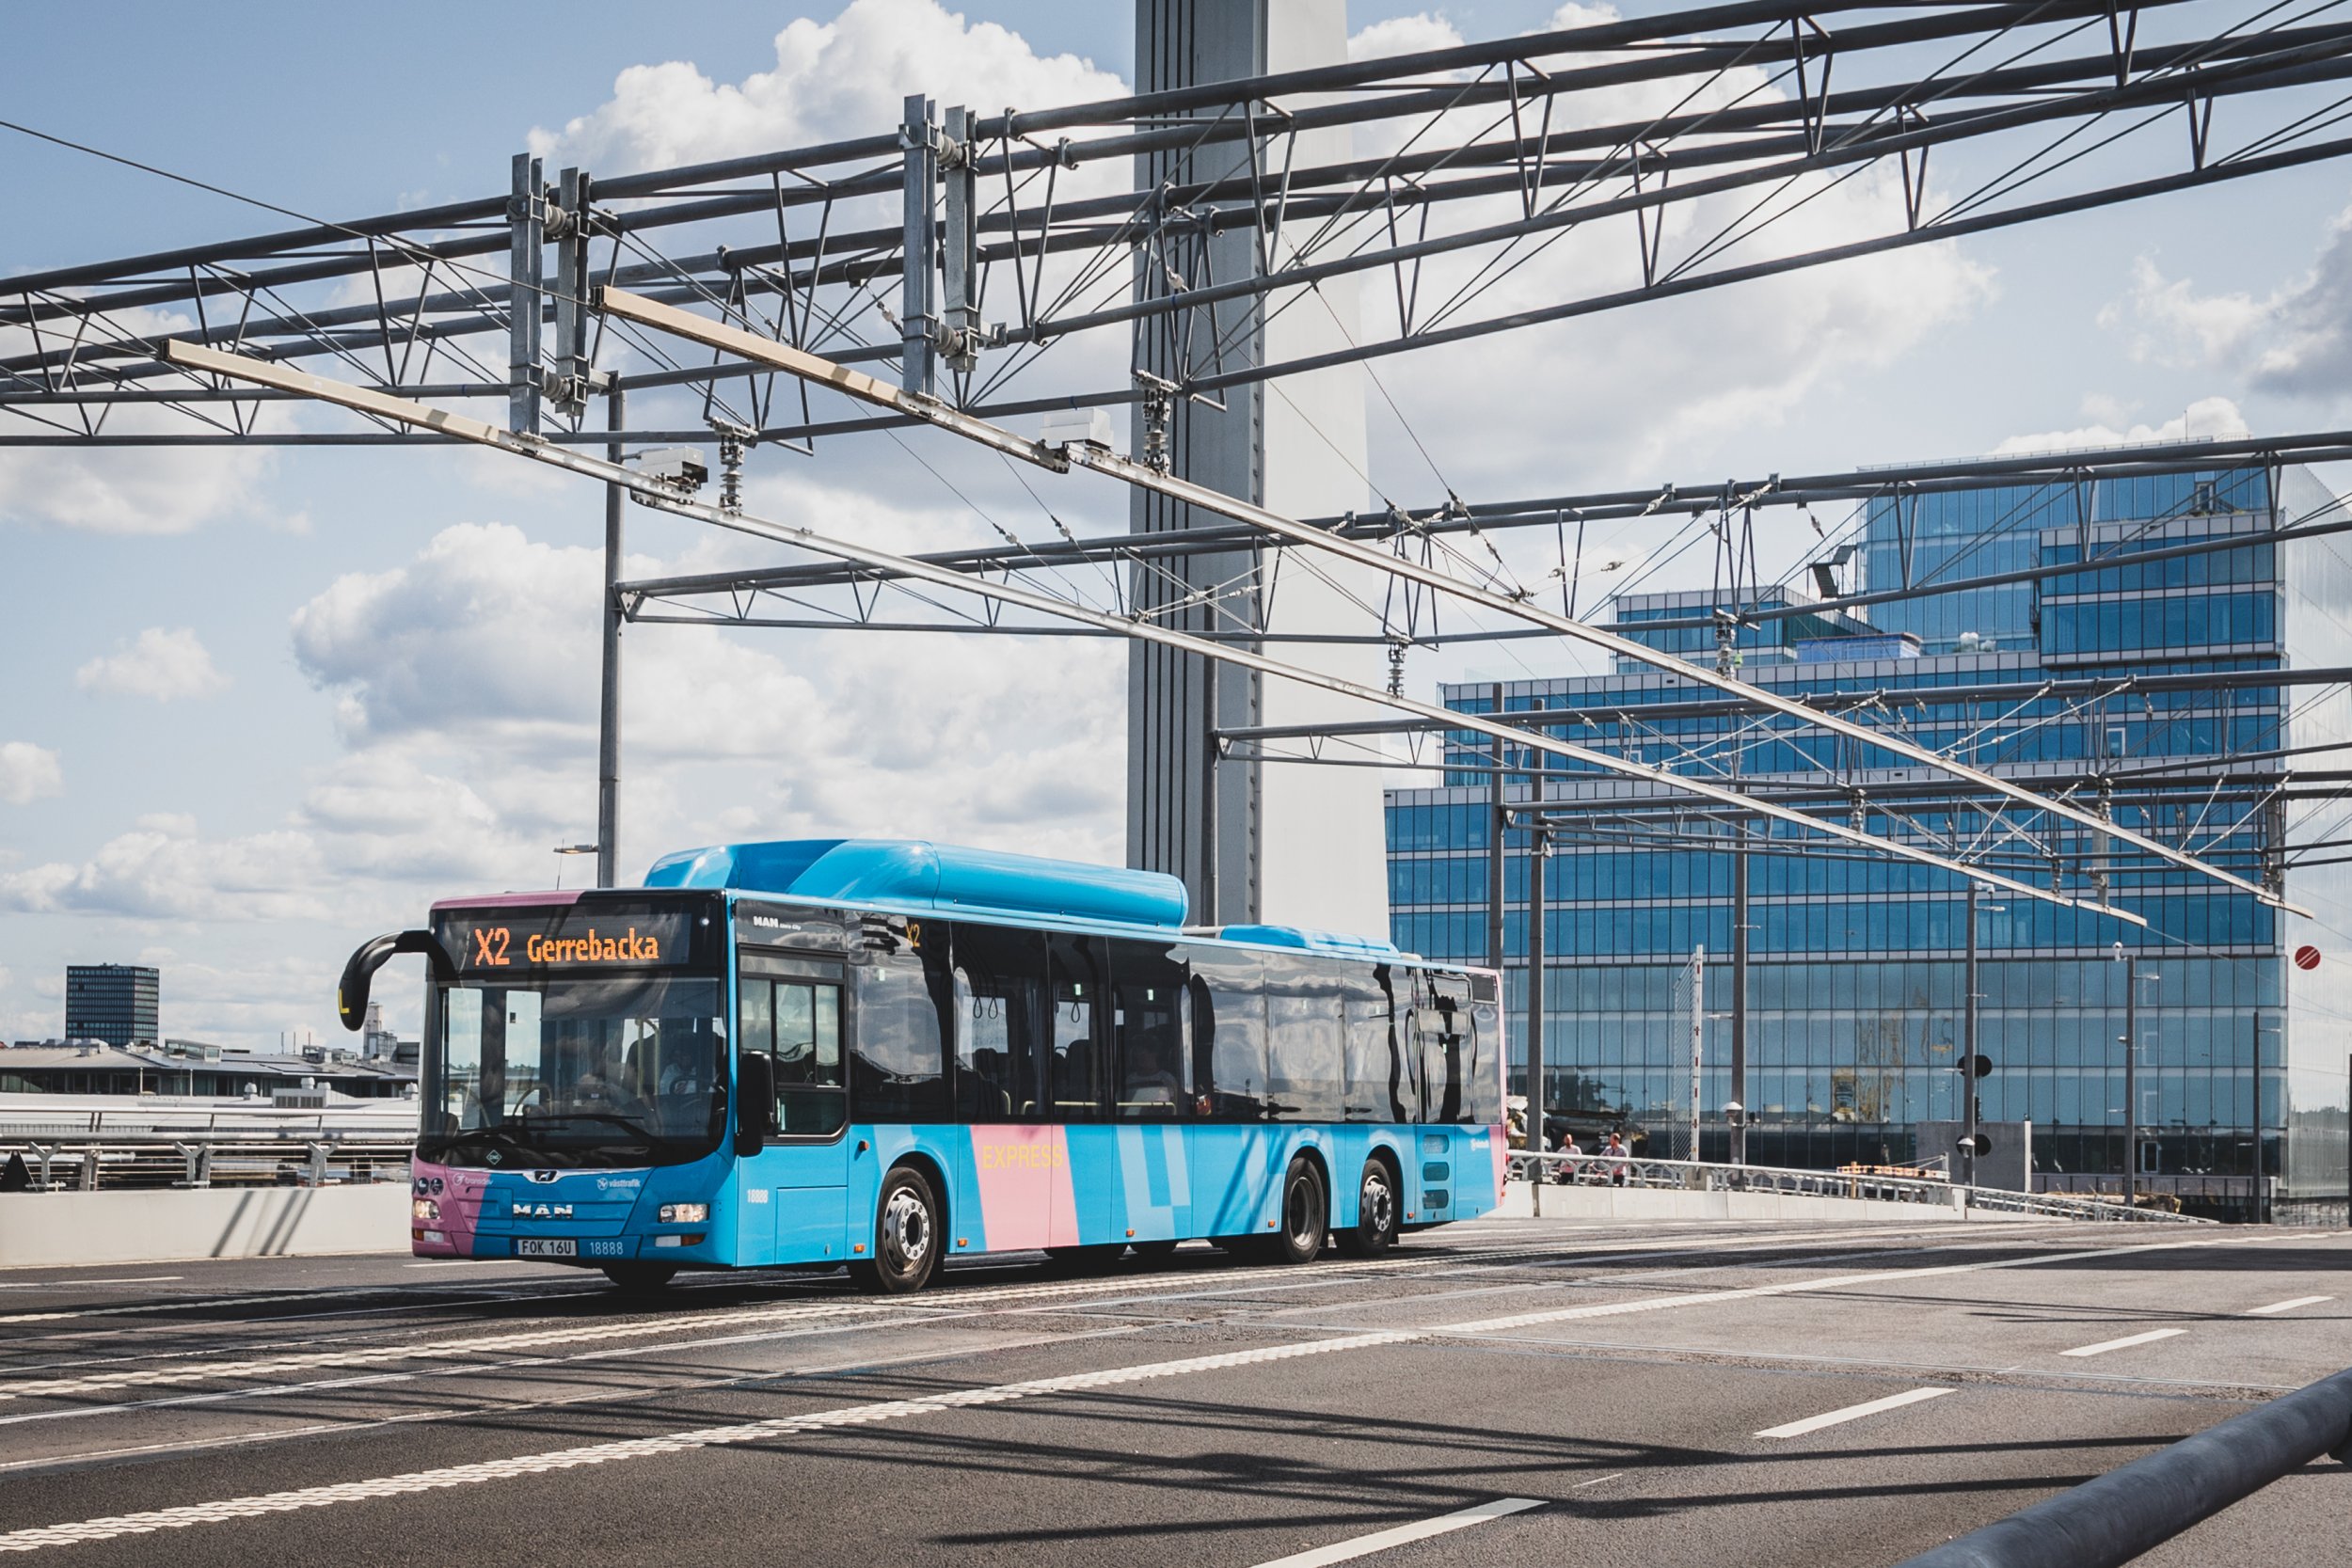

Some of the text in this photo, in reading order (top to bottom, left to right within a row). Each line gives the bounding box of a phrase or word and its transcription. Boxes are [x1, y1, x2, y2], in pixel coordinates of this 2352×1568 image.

[753, 915, 779, 928] MAN
[906, 924, 920, 947] X2
[475, 927, 659, 966] X2 Gerrebacka
[982, 1144, 1063, 1168] EXPRESS
[513, 1203, 573, 1218] MAN
[522, 1241, 545, 1254] FOK
[590, 1242, 624, 1255] 18888
